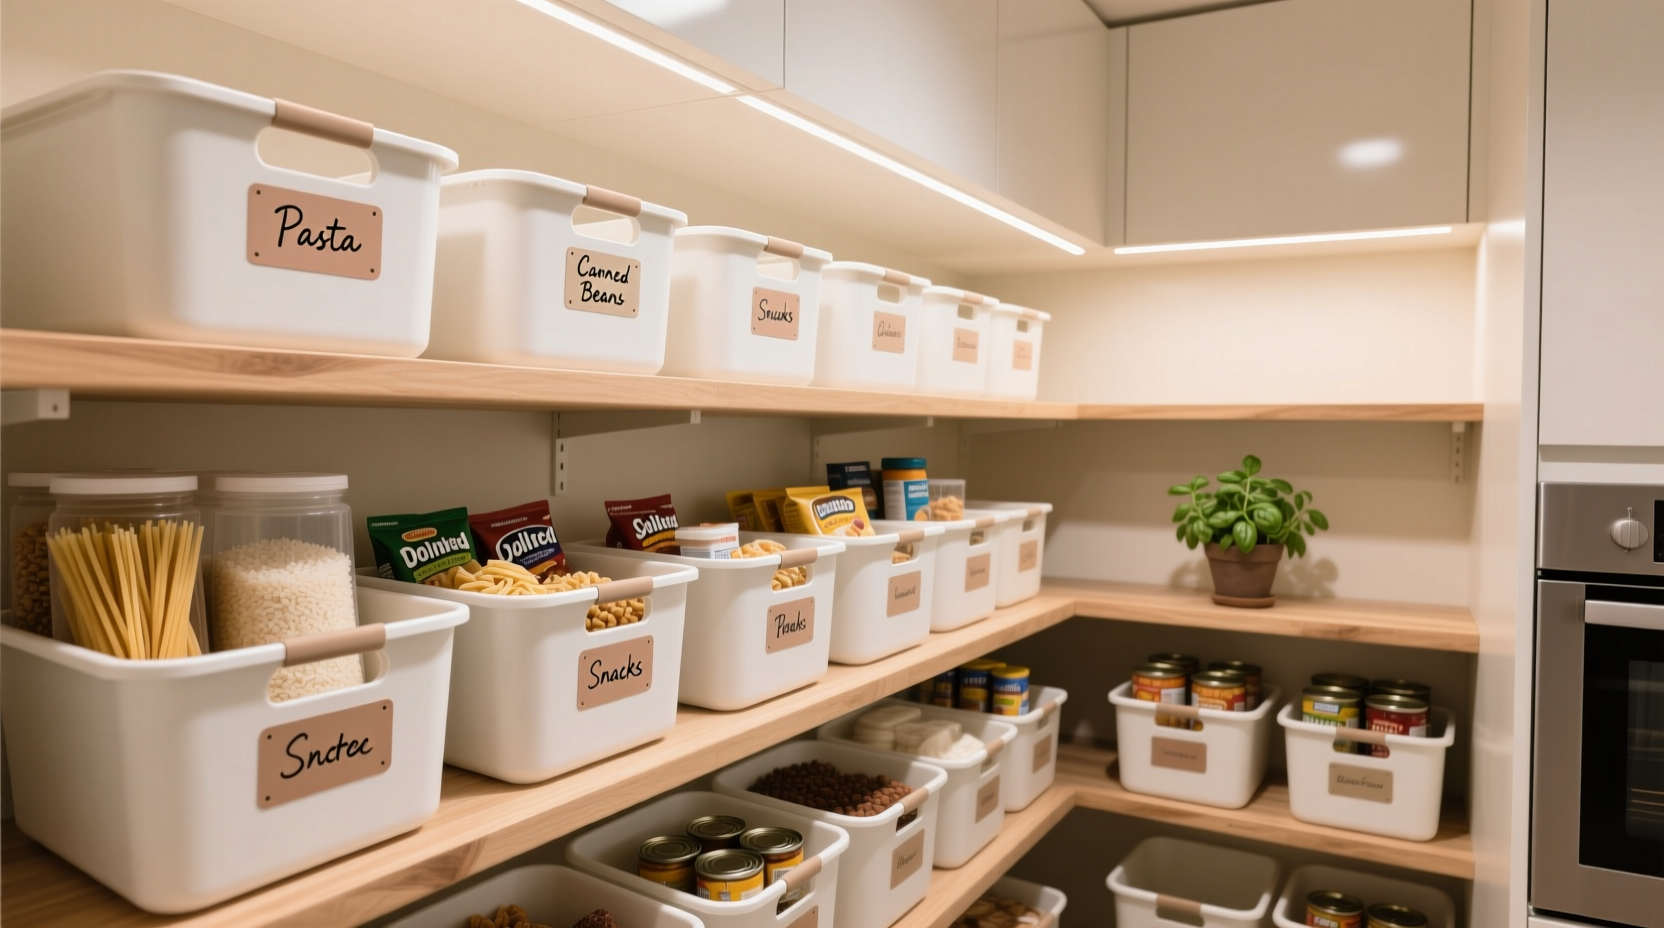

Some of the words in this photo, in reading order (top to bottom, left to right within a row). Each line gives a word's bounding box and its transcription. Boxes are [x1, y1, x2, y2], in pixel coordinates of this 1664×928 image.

[274, 204, 362, 252] Pasta
[577, 254, 631, 284] Canned
[580, 280, 625, 306] Beans
[587, 653, 643, 690] Snacks
